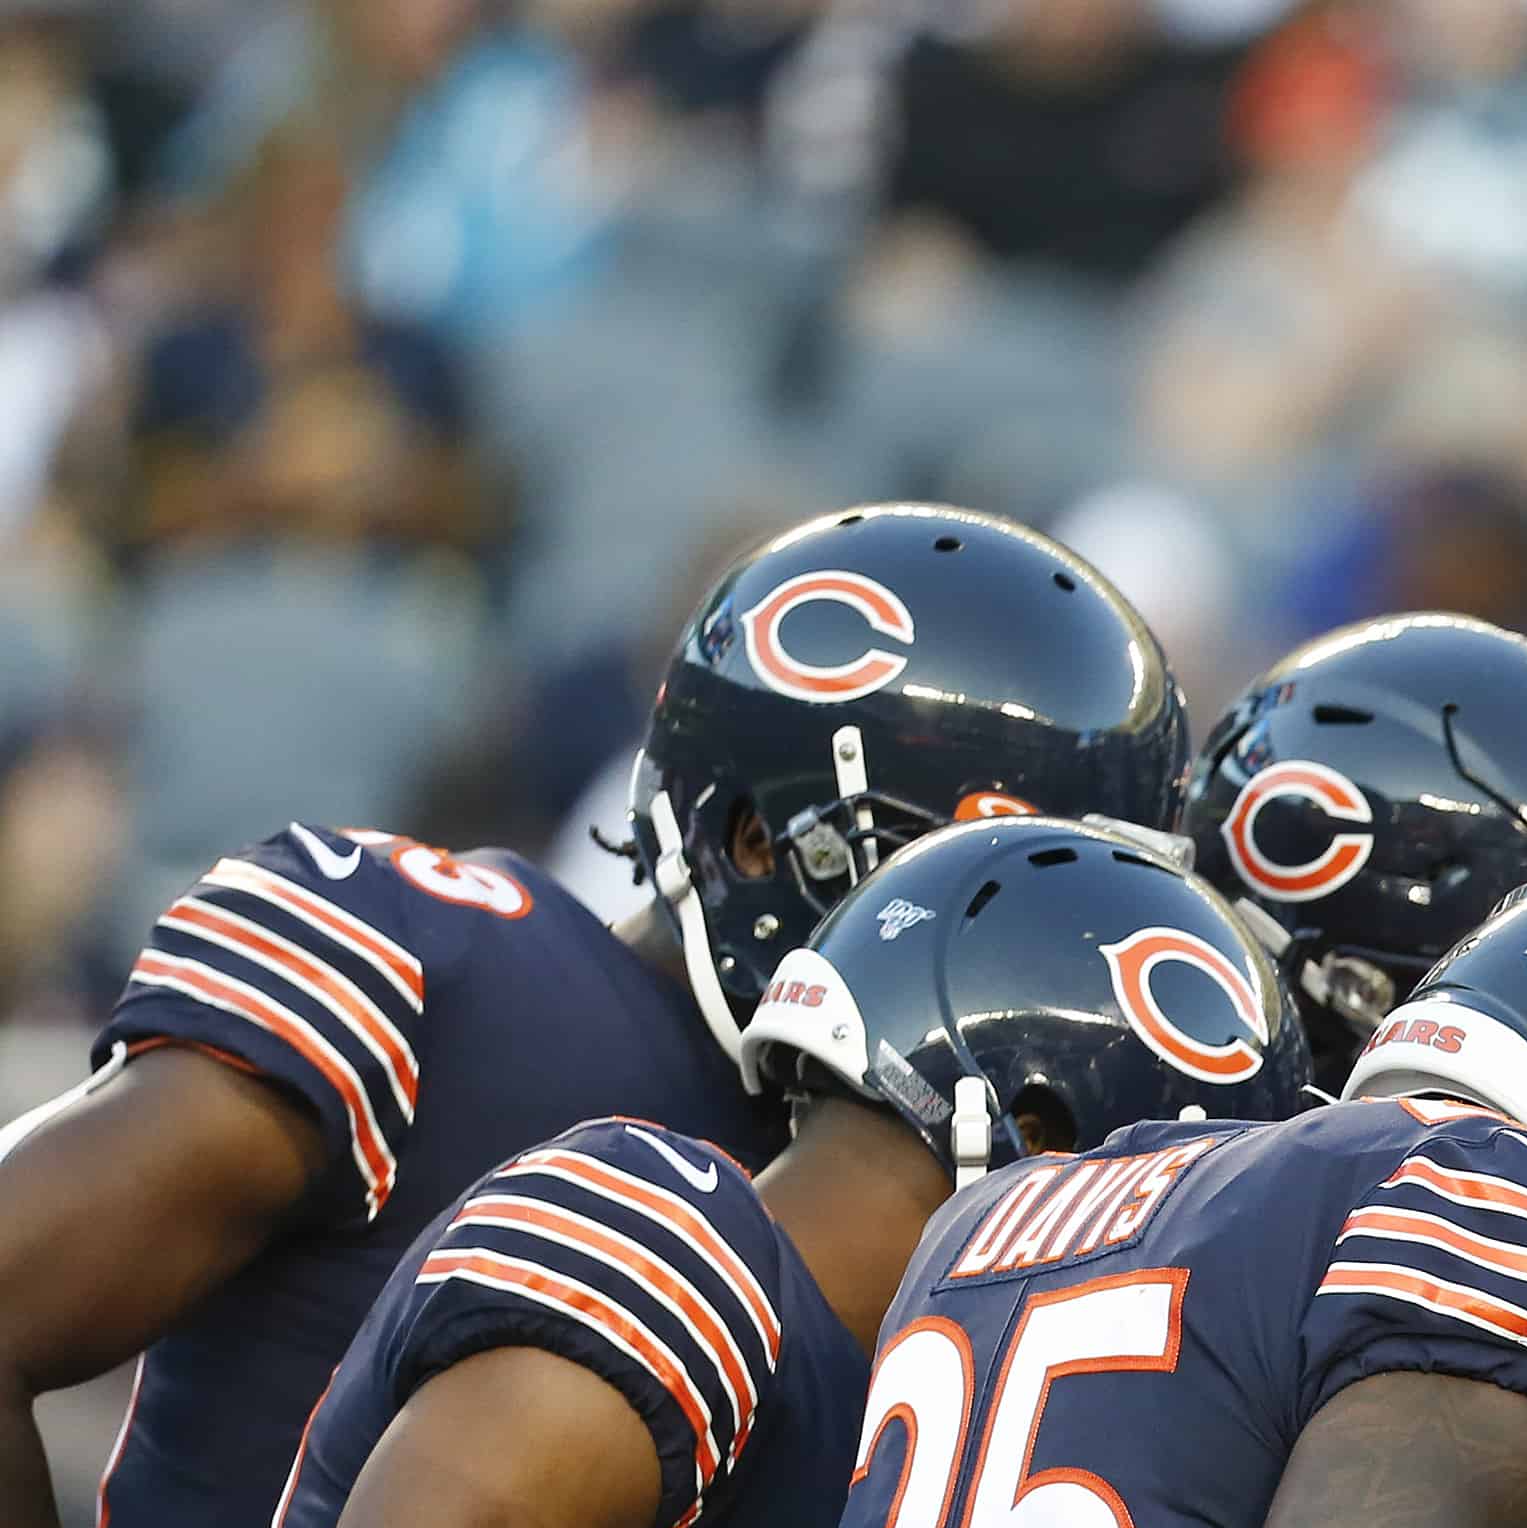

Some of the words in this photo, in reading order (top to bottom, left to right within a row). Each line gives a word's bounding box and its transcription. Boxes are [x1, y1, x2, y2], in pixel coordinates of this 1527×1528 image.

[741, 569, 914, 703] C
[1221, 759, 1374, 902] C
[1098, 925, 1269, 1085] C
[1361, 1019, 1466, 1055] ARS
[949, 1137, 1215, 1280] DAVIS
